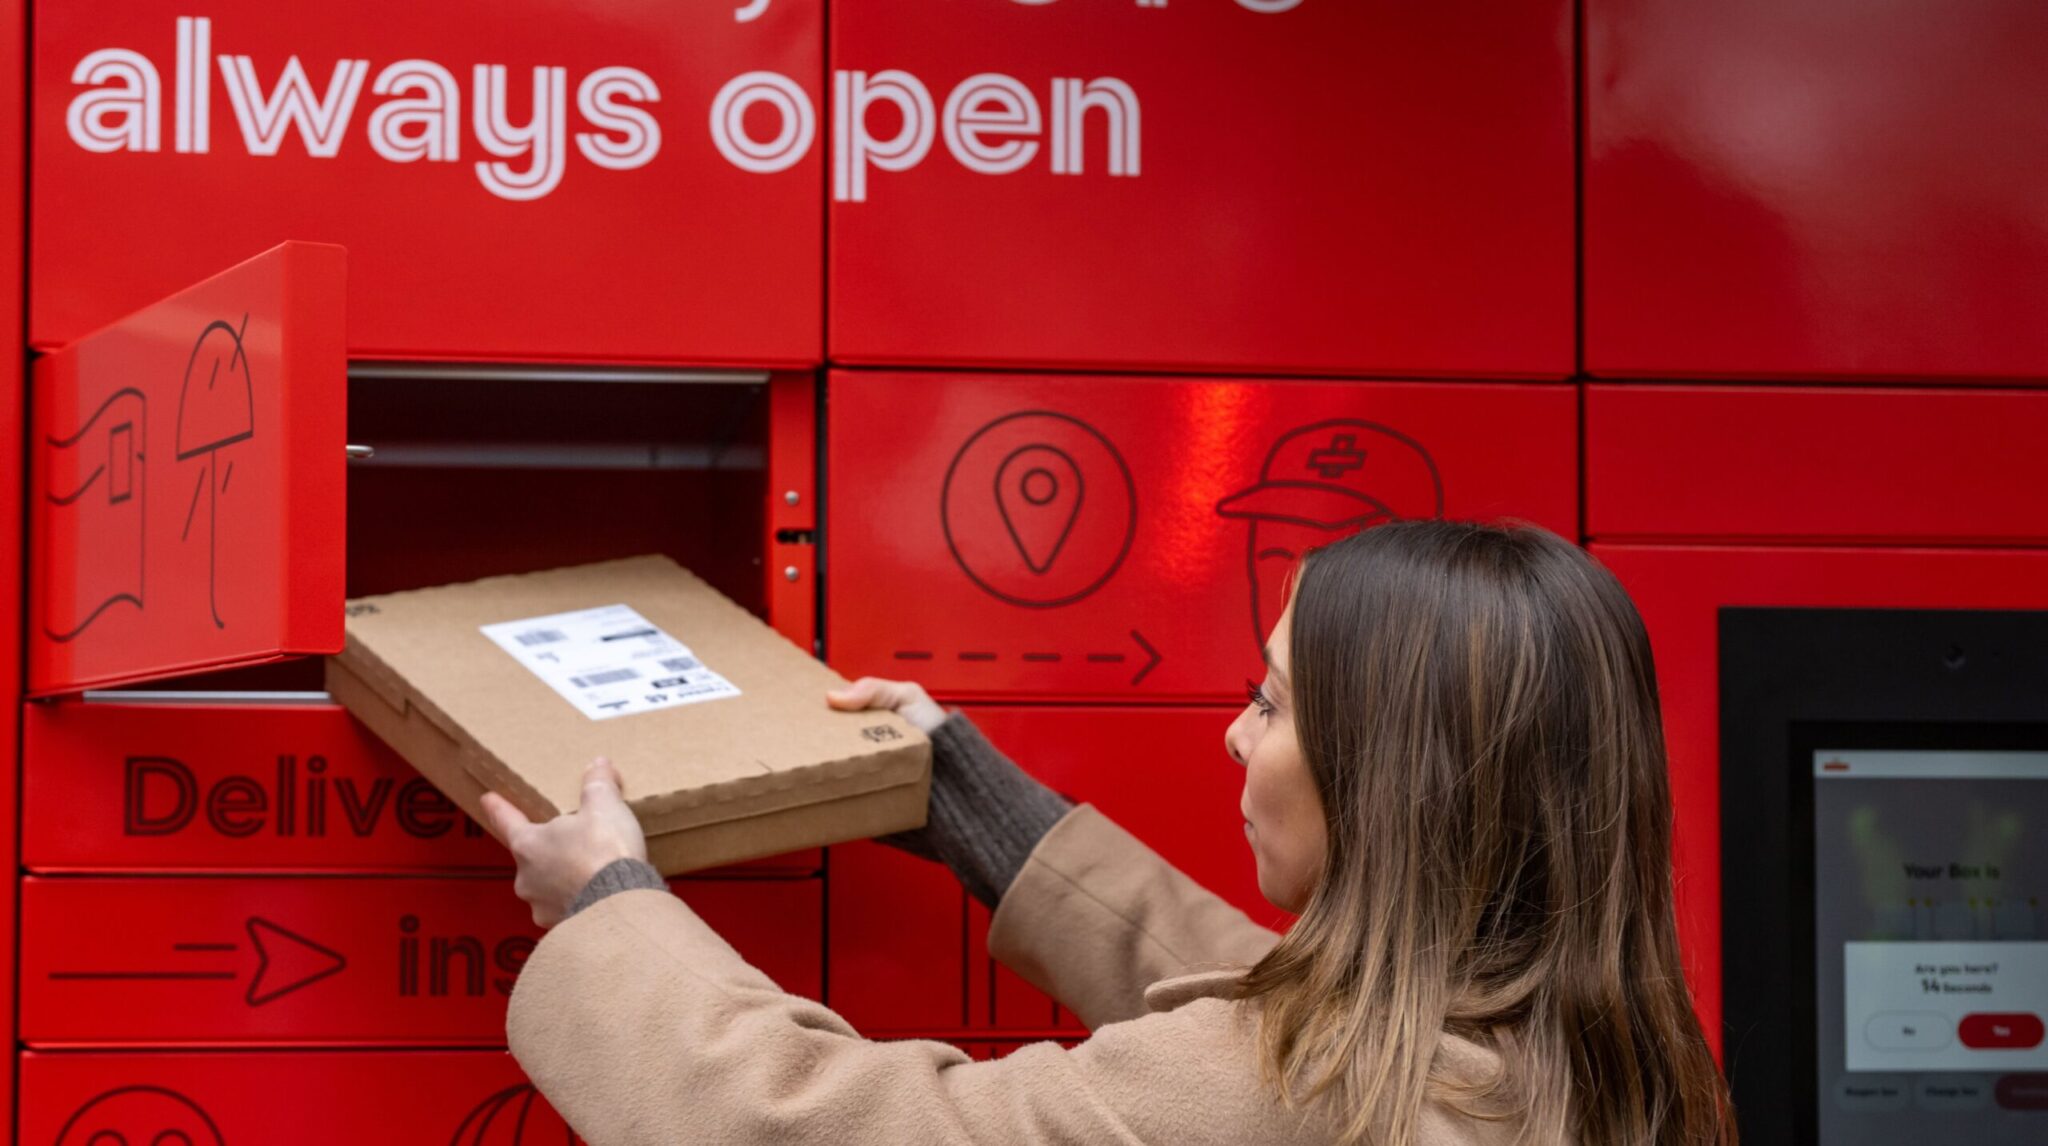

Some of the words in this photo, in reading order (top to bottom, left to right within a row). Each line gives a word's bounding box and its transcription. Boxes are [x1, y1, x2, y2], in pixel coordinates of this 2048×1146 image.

[66, 17, 662, 200] always
[709, 70, 1141, 202] open
[1903, 860, 1943, 881] Your
[1947, 862, 1980, 881] Box
[1915, 963, 1936, 974] Are
[1937, 964, 1960, 977] you
[1963, 961, 1999, 974] here?
[1921, 977, 1940, 992] 14
